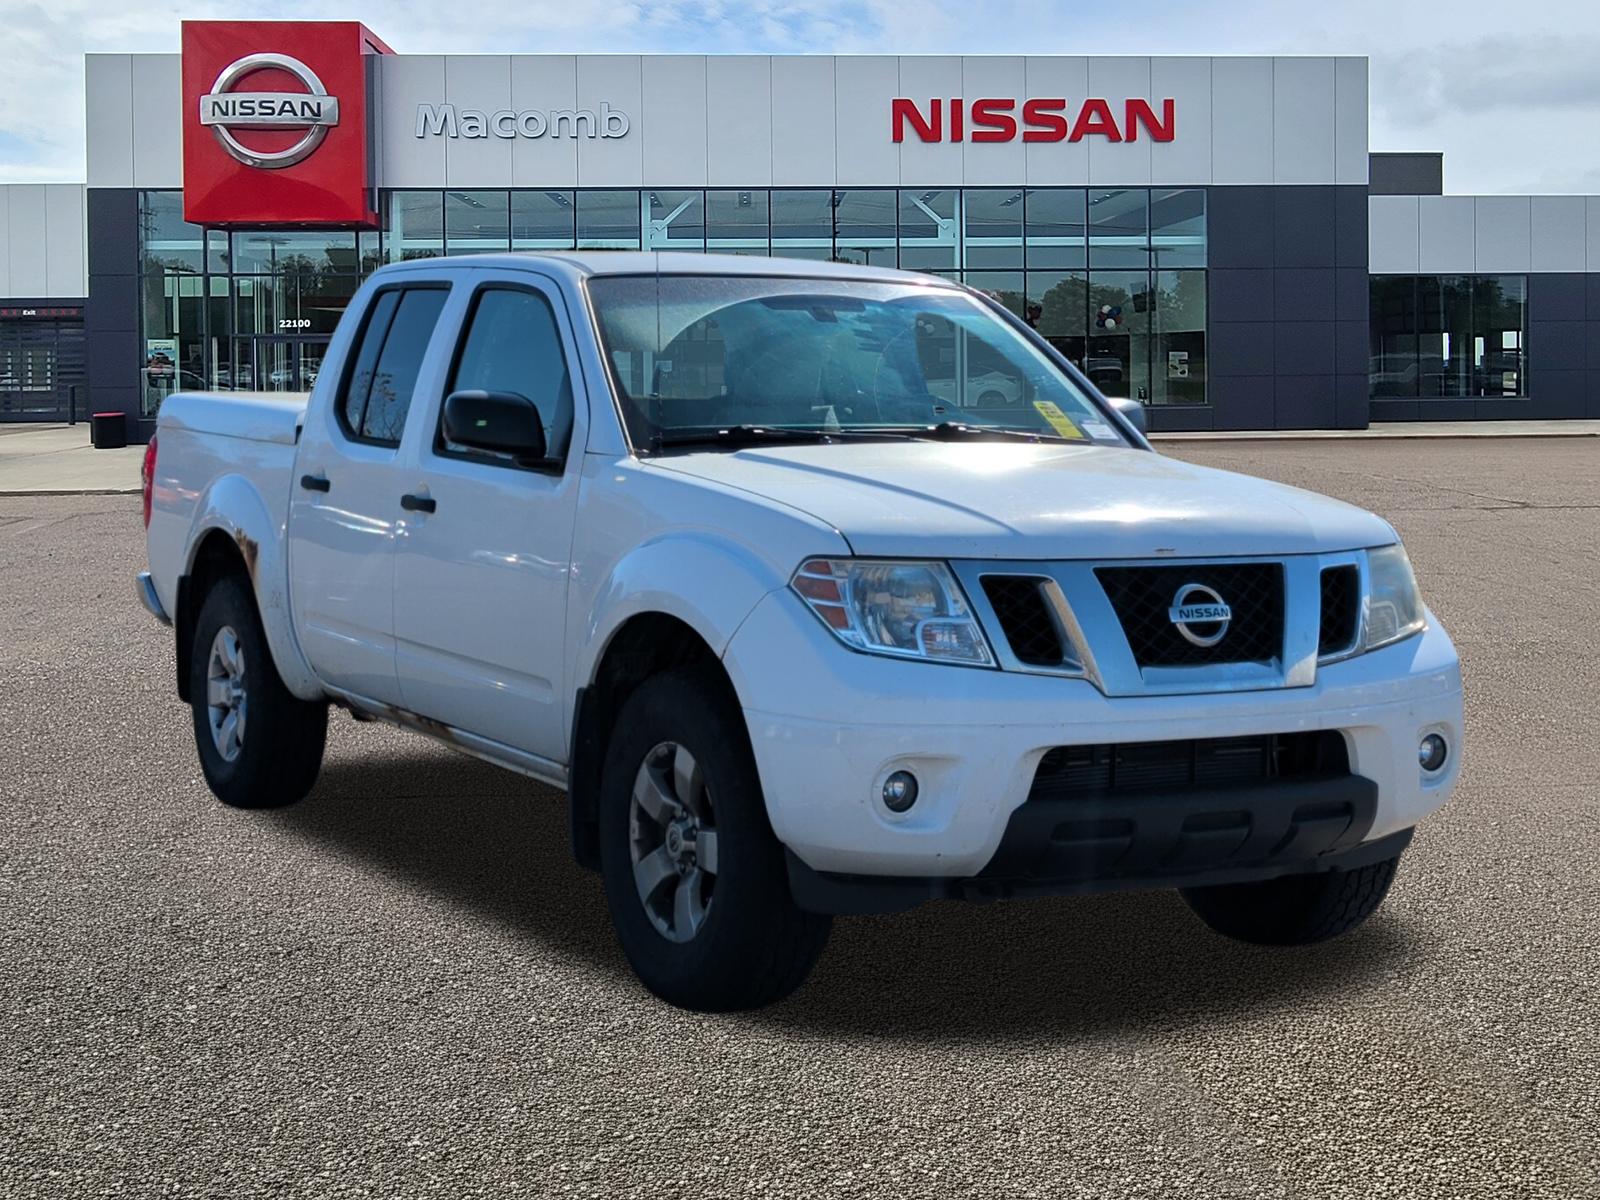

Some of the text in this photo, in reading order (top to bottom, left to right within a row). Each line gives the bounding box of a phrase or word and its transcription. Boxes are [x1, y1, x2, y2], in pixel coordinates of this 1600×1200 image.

[212, 100, 322, 117] NISSAN
[415, 101, 630, 139] Macomb
[892, 98, 1175, 142] NISSAN
[279, 319, 311, 328] 22100
[1178, 607, 1229, 619] NISSAN
